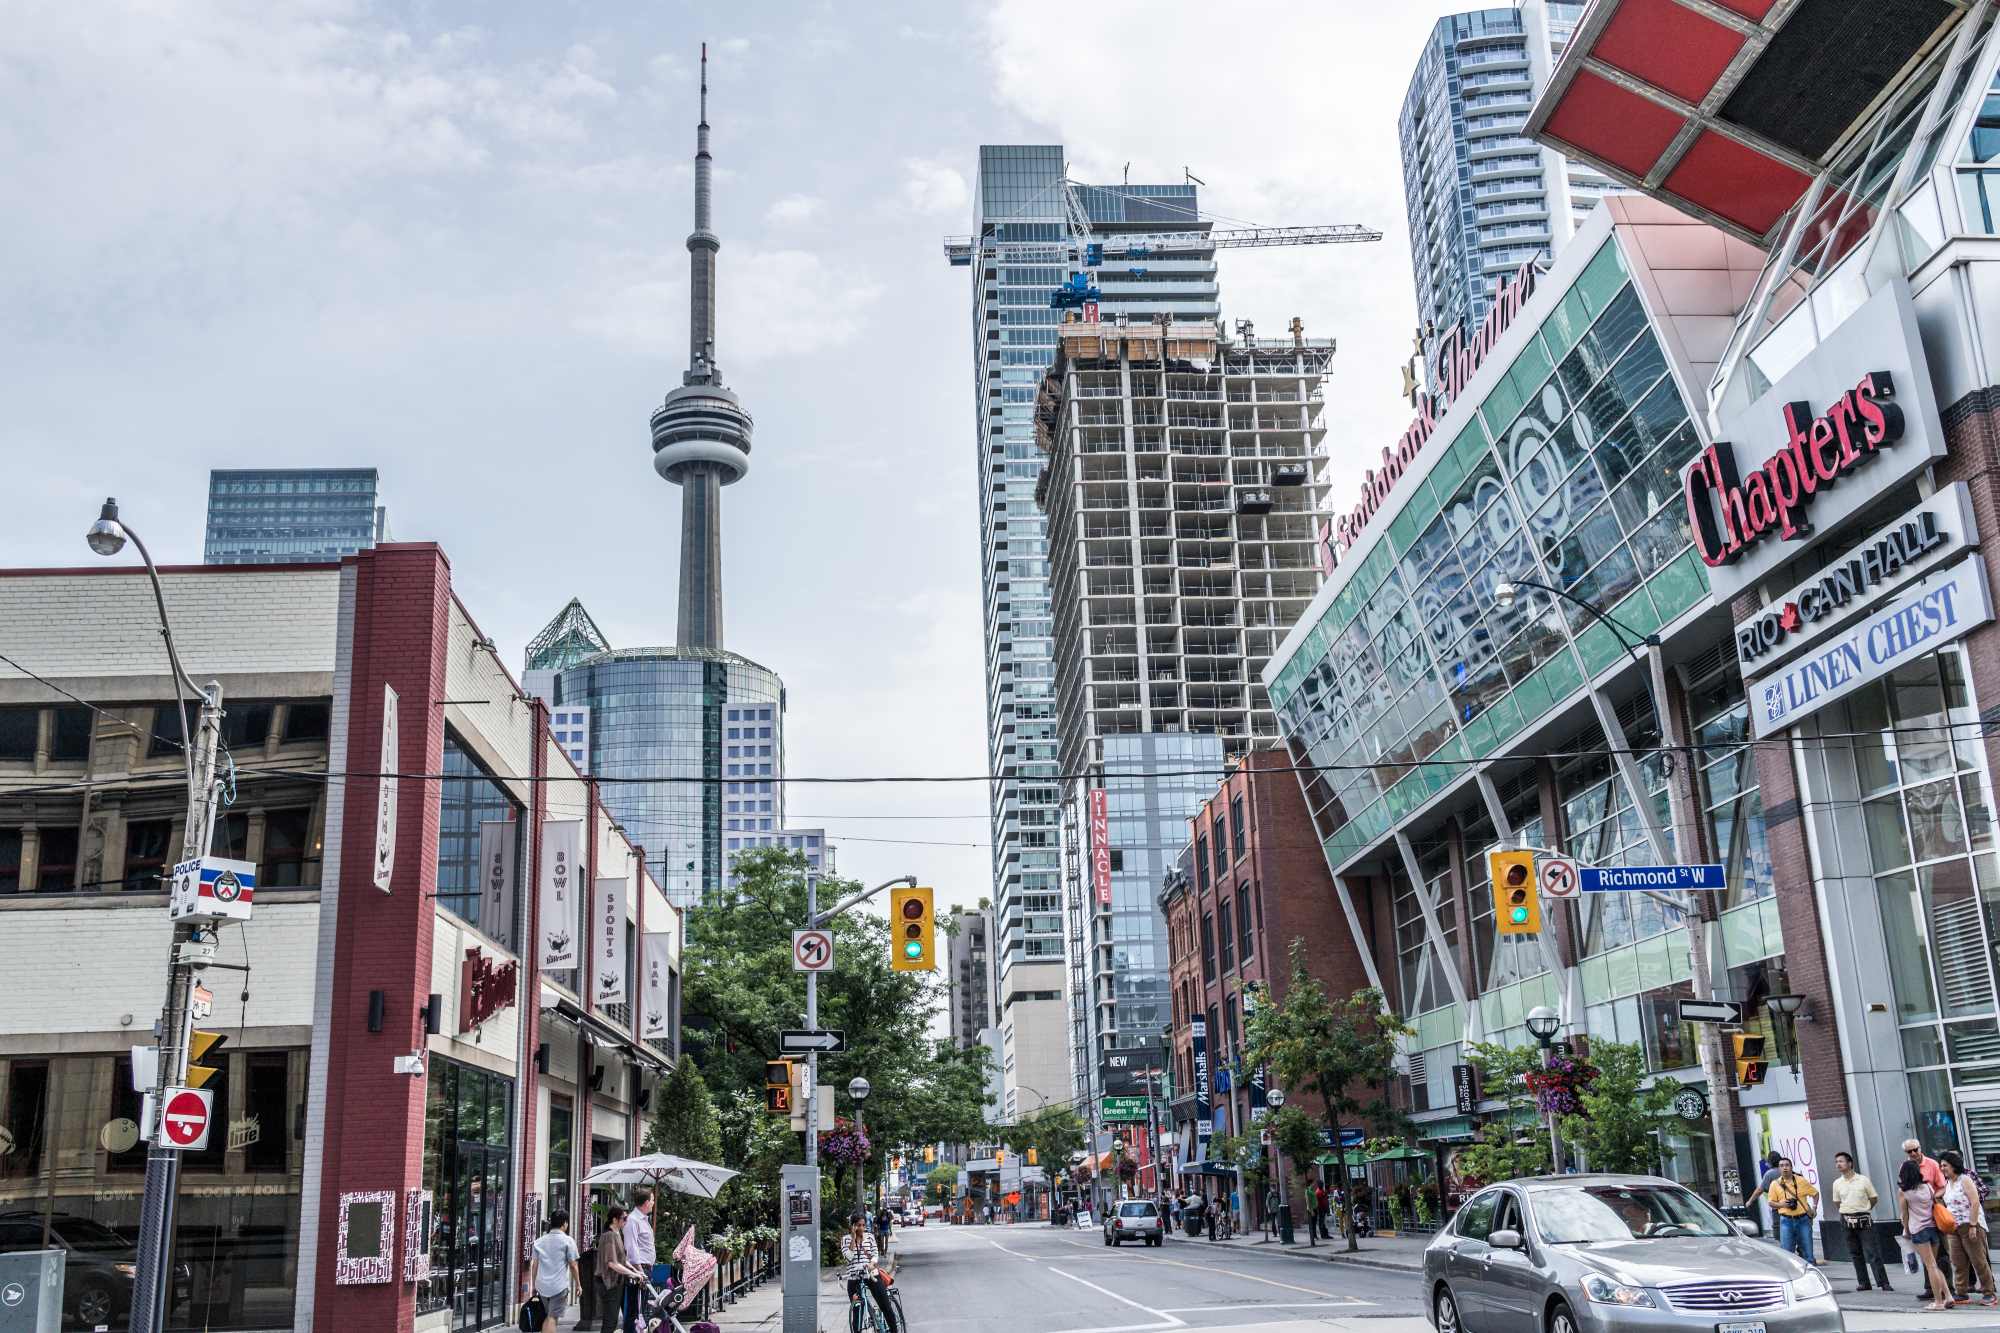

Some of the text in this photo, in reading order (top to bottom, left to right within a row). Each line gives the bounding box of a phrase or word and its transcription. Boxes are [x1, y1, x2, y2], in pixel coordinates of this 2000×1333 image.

[1337, 392, 1436, 550] Scotiabank
[1684, 371, 1902, 567] Chapters
[1738, 612, 1786, 662] RIO
[1861, 512, 1946, 588] HALL
[1786, 580, 1959, 711] LINEN CHEST
[175, 860, 201, 876] POLICE
[1095, 791, 1109, 901] PINNACLE
[553, 851, 567, 901] BOWL
[1599, 867, 1705, 886] Richmond St W
[605, 894, 615, 958] SPORTS
[651, 961, 659, 987] BAR
[1109, 1056, 1127, 1067] NEW
[1195, 1051, 1209, 1106] Marshalls
[1748, 1063, 1757, 1080] 12
[1115, 1099, 1141, 1107] Active
[1460, 1067, 1471, 1112] milestones
[95, 1190, 135, 1201] BOWL
